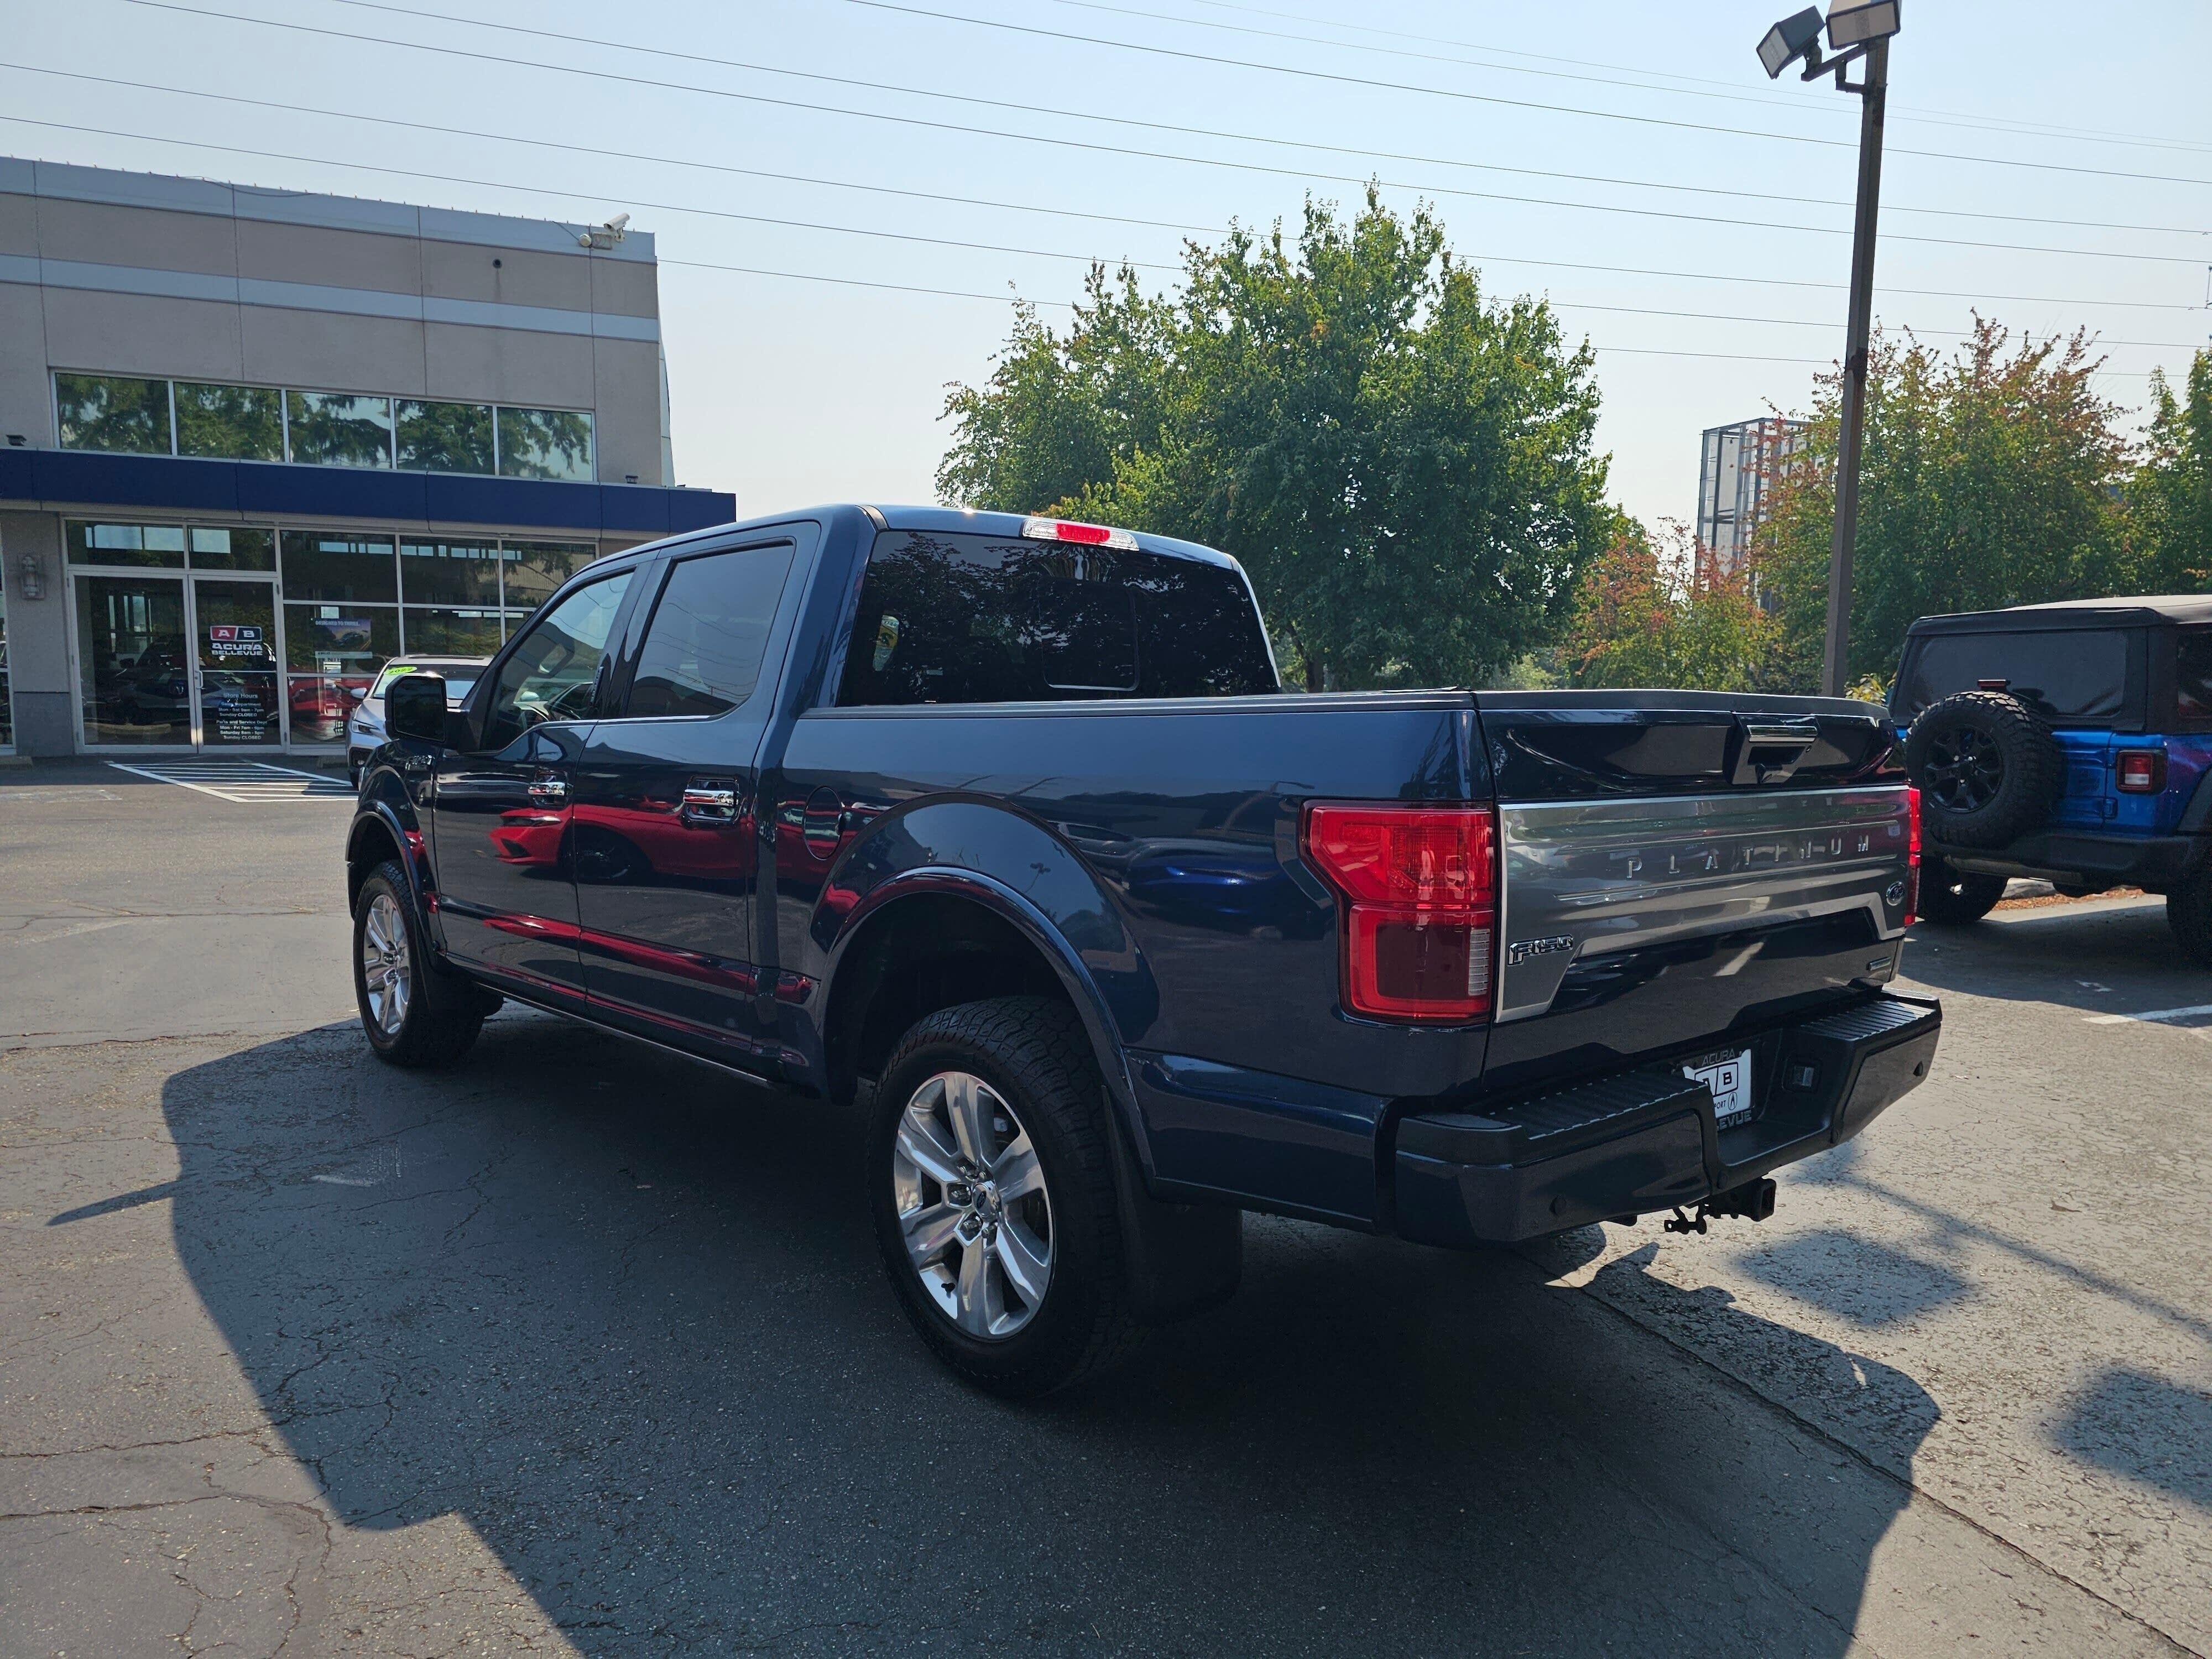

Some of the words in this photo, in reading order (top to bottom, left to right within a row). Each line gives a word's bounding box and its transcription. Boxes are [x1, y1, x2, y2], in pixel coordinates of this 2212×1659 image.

[1626, 834, 1869, 879] PLATINUM
[1702, 1048, 1735, 1067] ACURA
[1723, 1071, 1732, 1086] B
[1717, 1110, 1752, 1130] EVUE
